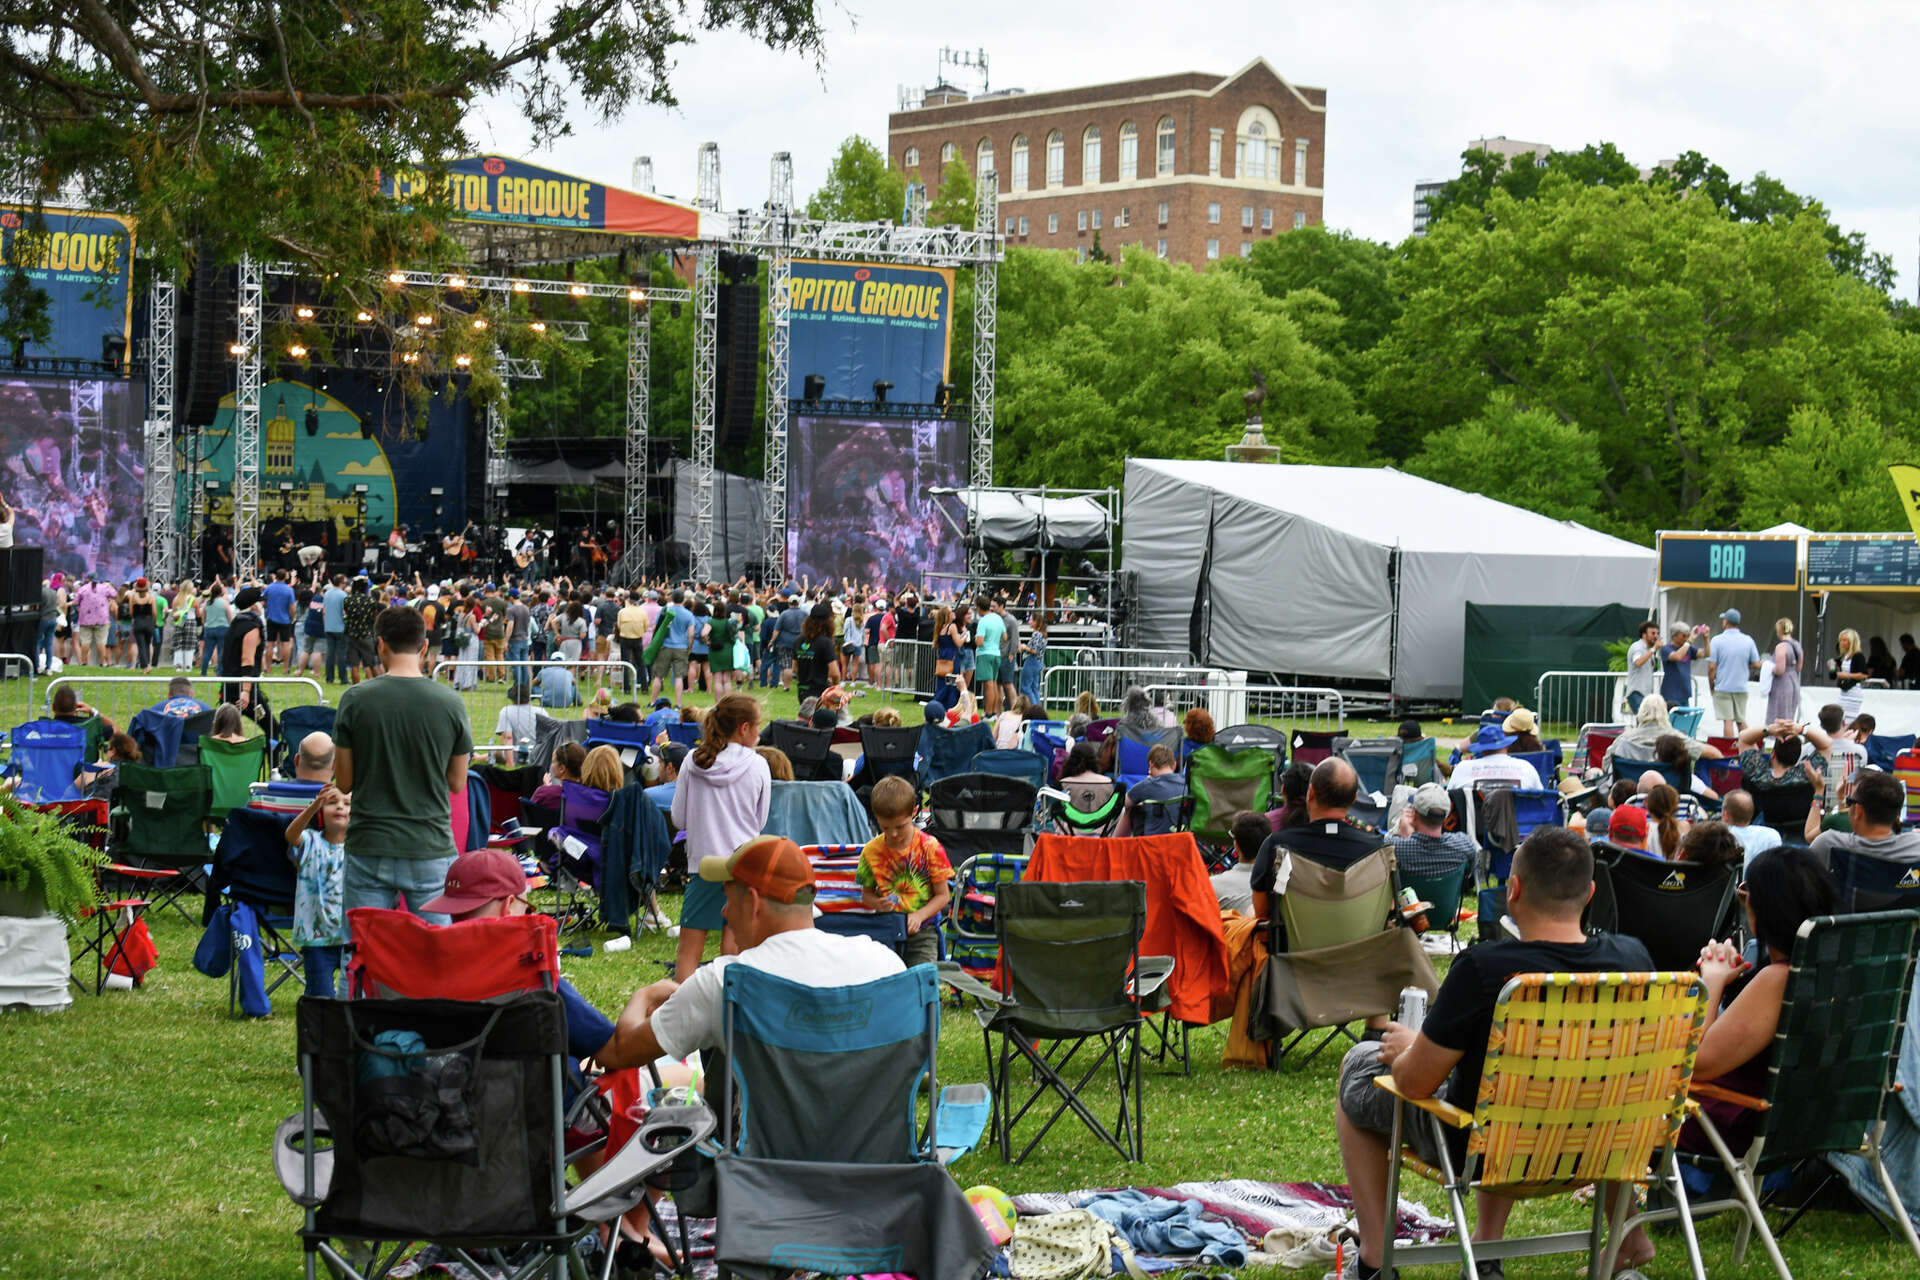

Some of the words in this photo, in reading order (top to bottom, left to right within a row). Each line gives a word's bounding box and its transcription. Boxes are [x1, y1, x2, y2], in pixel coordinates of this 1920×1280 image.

[497, 176, 591, 220] GROOVE
[860, 281, 942, 320] GROOVE
[867, 317, 885, 325] PARK
[1710, 544, 1745, 578] BAR
